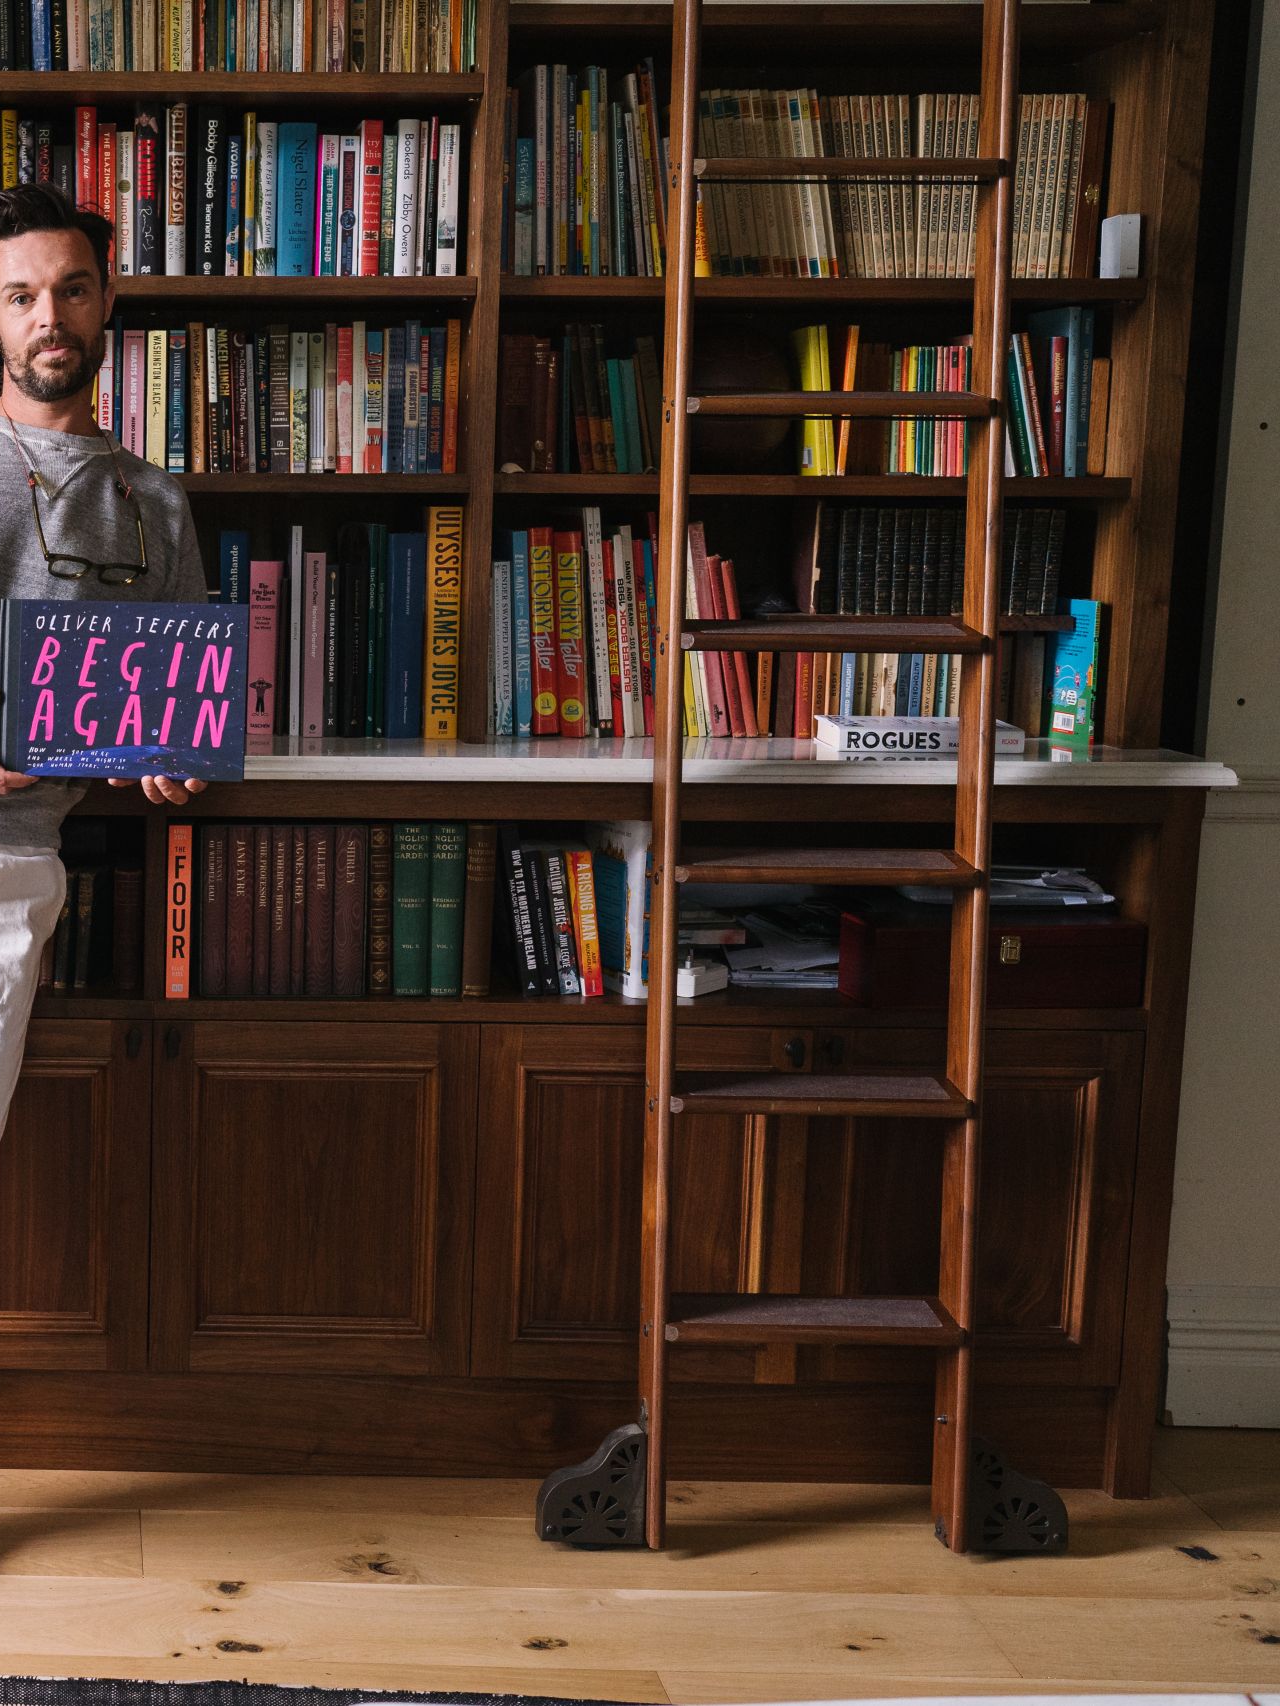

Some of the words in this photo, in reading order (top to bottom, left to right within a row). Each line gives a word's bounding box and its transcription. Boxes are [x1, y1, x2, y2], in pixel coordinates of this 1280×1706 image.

[172, 27, 181, 66] VONNEGUT
[205, 120, 218, 153] Bobby
[1051, 120, 1060, 158] WONDERFUL
[293, 139, 308, 174] Nigel
[365, 150, 381, 158] this
[403, 133, 414, 179] Bookends
[1049, 160, 1058, 180] WORLD
[205, 156, 216, 198] Gillespie
[1048, 182, 1054, 190] OF
[120, 196, 129, 224] Junot
[293, 178, 307, 216] Slater
[401, 194, 412, 221] Zibby
[1043, 193, 1053, 232] KNOWLEDGE
[205, 202, 213, 238] Tenement
[121, 229, 131, 251] Díaz
[204, 240, 212, 253] Kid
[401, 225, 410, 256] Owens
[152, 335, 162, 380] WASHINGTON
[217, 329, 228, 361] NAKED
[1081, 349, 1089, 357] UP
[219, 364, 230, 396] LUNCH
[367, 352, 382, 384] ZADIE
[1053, 352, 1062, 395] MOOMINLAND
[1080, 359, 1089, 382] DOWN
[152, 384, 161, 404] BLACK
[367, 391, 382, 422] SMITH
[1080, 384, 1088, 406] INSIDE
[435, 510, 460, 587] ULYSSES
[531, 546, 552, 633] STORY
[558, 553, 581, 640] STORY
[617, 578, 626, 606] 1988
[36, 614, 112, 633] OLIVER
[136, 616, 234, 639] JEFFERS
[431, 600, 457, 656] JAMES
[619, 611, 627, 650] BOOK
[31, 636, 233, 694] BEGIN
[532, 633, 553, 672] Teller
[560, 640, 581, 678] Teller
[431, 663, 456, 714] JOYCE
[622, 654, 631, 692] BUSTER
[631, 675, 639, 702] STORIES
[911, 662, 920, 708] AUTOMOBILES
[28, 689, 229, 749] AGAIN
[846, 731, 941, 750] ROGUES
[236, 840, 246, 866] JANE
[259, 840, 267, 858] THE
[294, 840, 304, 874] AGNES
[316, 840, 326, 890] VILLETTE
[345, 840, 356, 884] SHIRLEY
[511, 850, 521, 865] HOW
[275, 841, 285, 891] WUTHERING
[514, 869, 523, 879] TO
[548, 857, 565, 895] ANCILLARY
[576, 863, 589, 871] A
[236, 869, 245, 897] EYRE
[258, 860, 267, 907] PROFESSOR
[293, 877, 304, 905] GREY
[515, 881, 525, 893] FIX
[578, 873, 594, 911] RISING
[171, 855, 187, 959] FOUR
[275, 894, 284, 930] HEIGHTS
[518, 895, 532, 935] NORTHERN
[552, 897, 568, 926] JUSTICE
[559, 934, 568, 947] ANN
[580, 914, 596, 941] MAN
[523, 937, 537, 970] IRELAND
[560, 948, 571, 968] LECKIE
